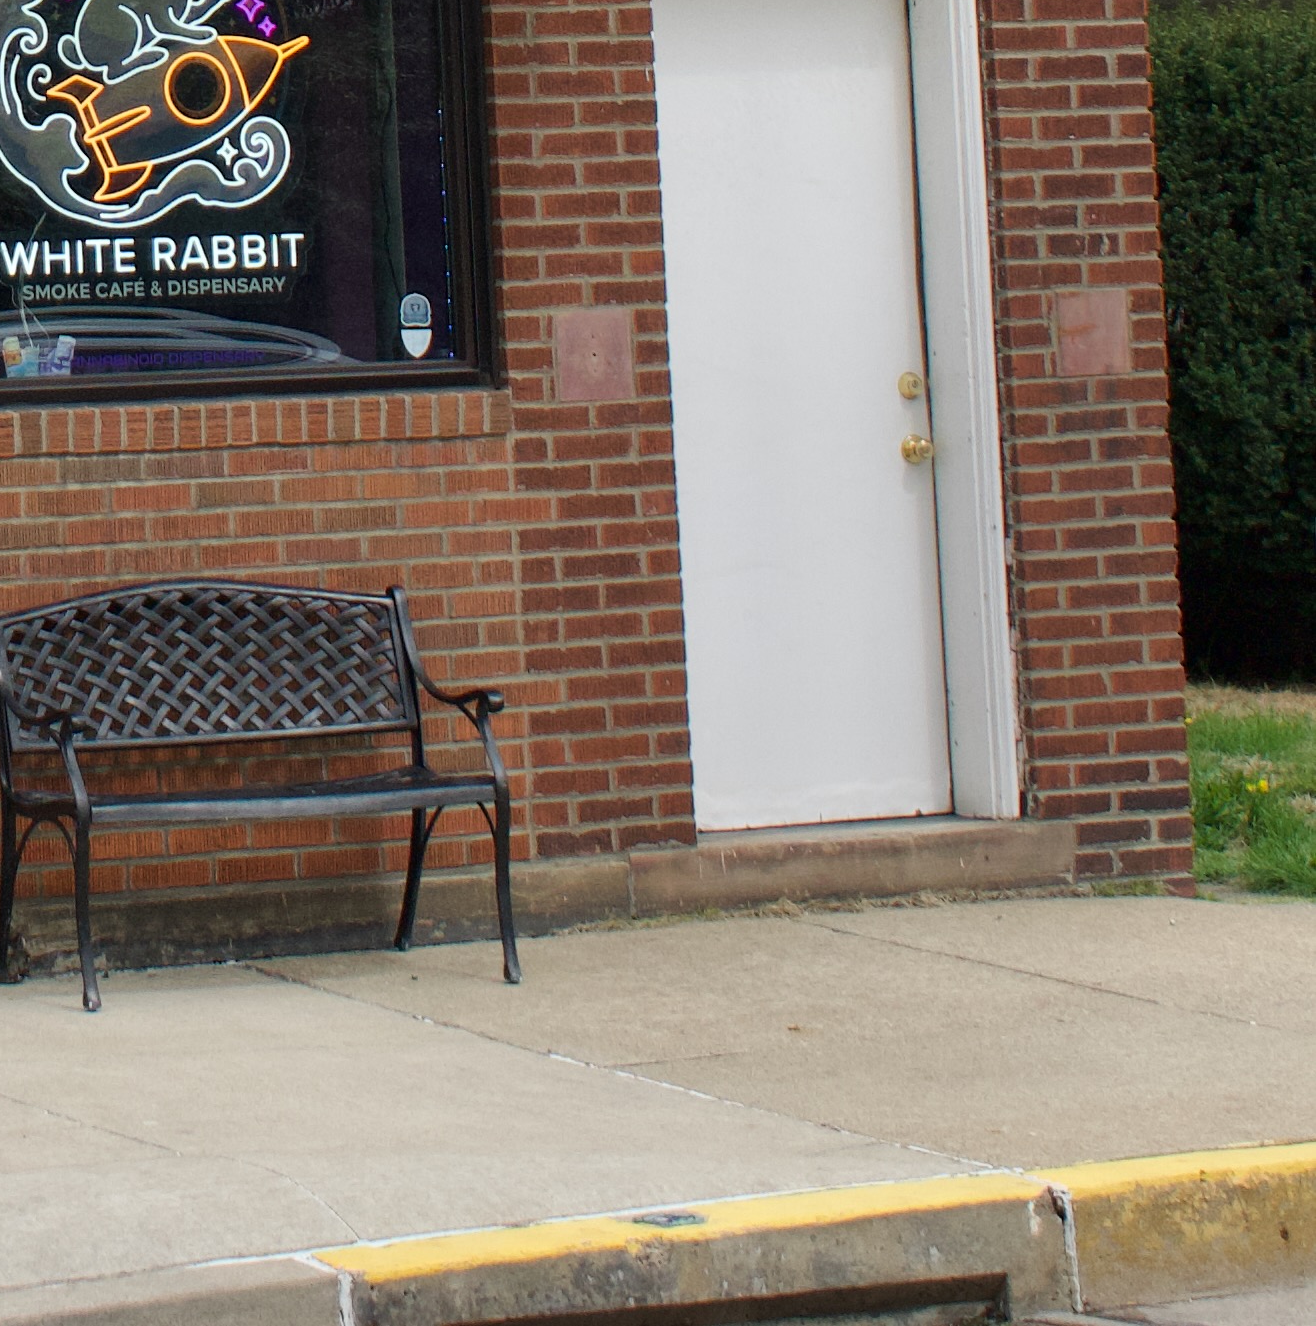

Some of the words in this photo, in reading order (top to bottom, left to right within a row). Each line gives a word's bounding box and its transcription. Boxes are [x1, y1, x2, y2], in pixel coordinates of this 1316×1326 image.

[0, 238, 137, 277] WHITE
[151, 232, 306, 272] RABBIT
[21, 283, 91, 301] SMOKE
[95, 277, 146, 299] CAFÉ
[150, 280, 164, 297] &
[168, 276, 287, 297] DISPENSARY
